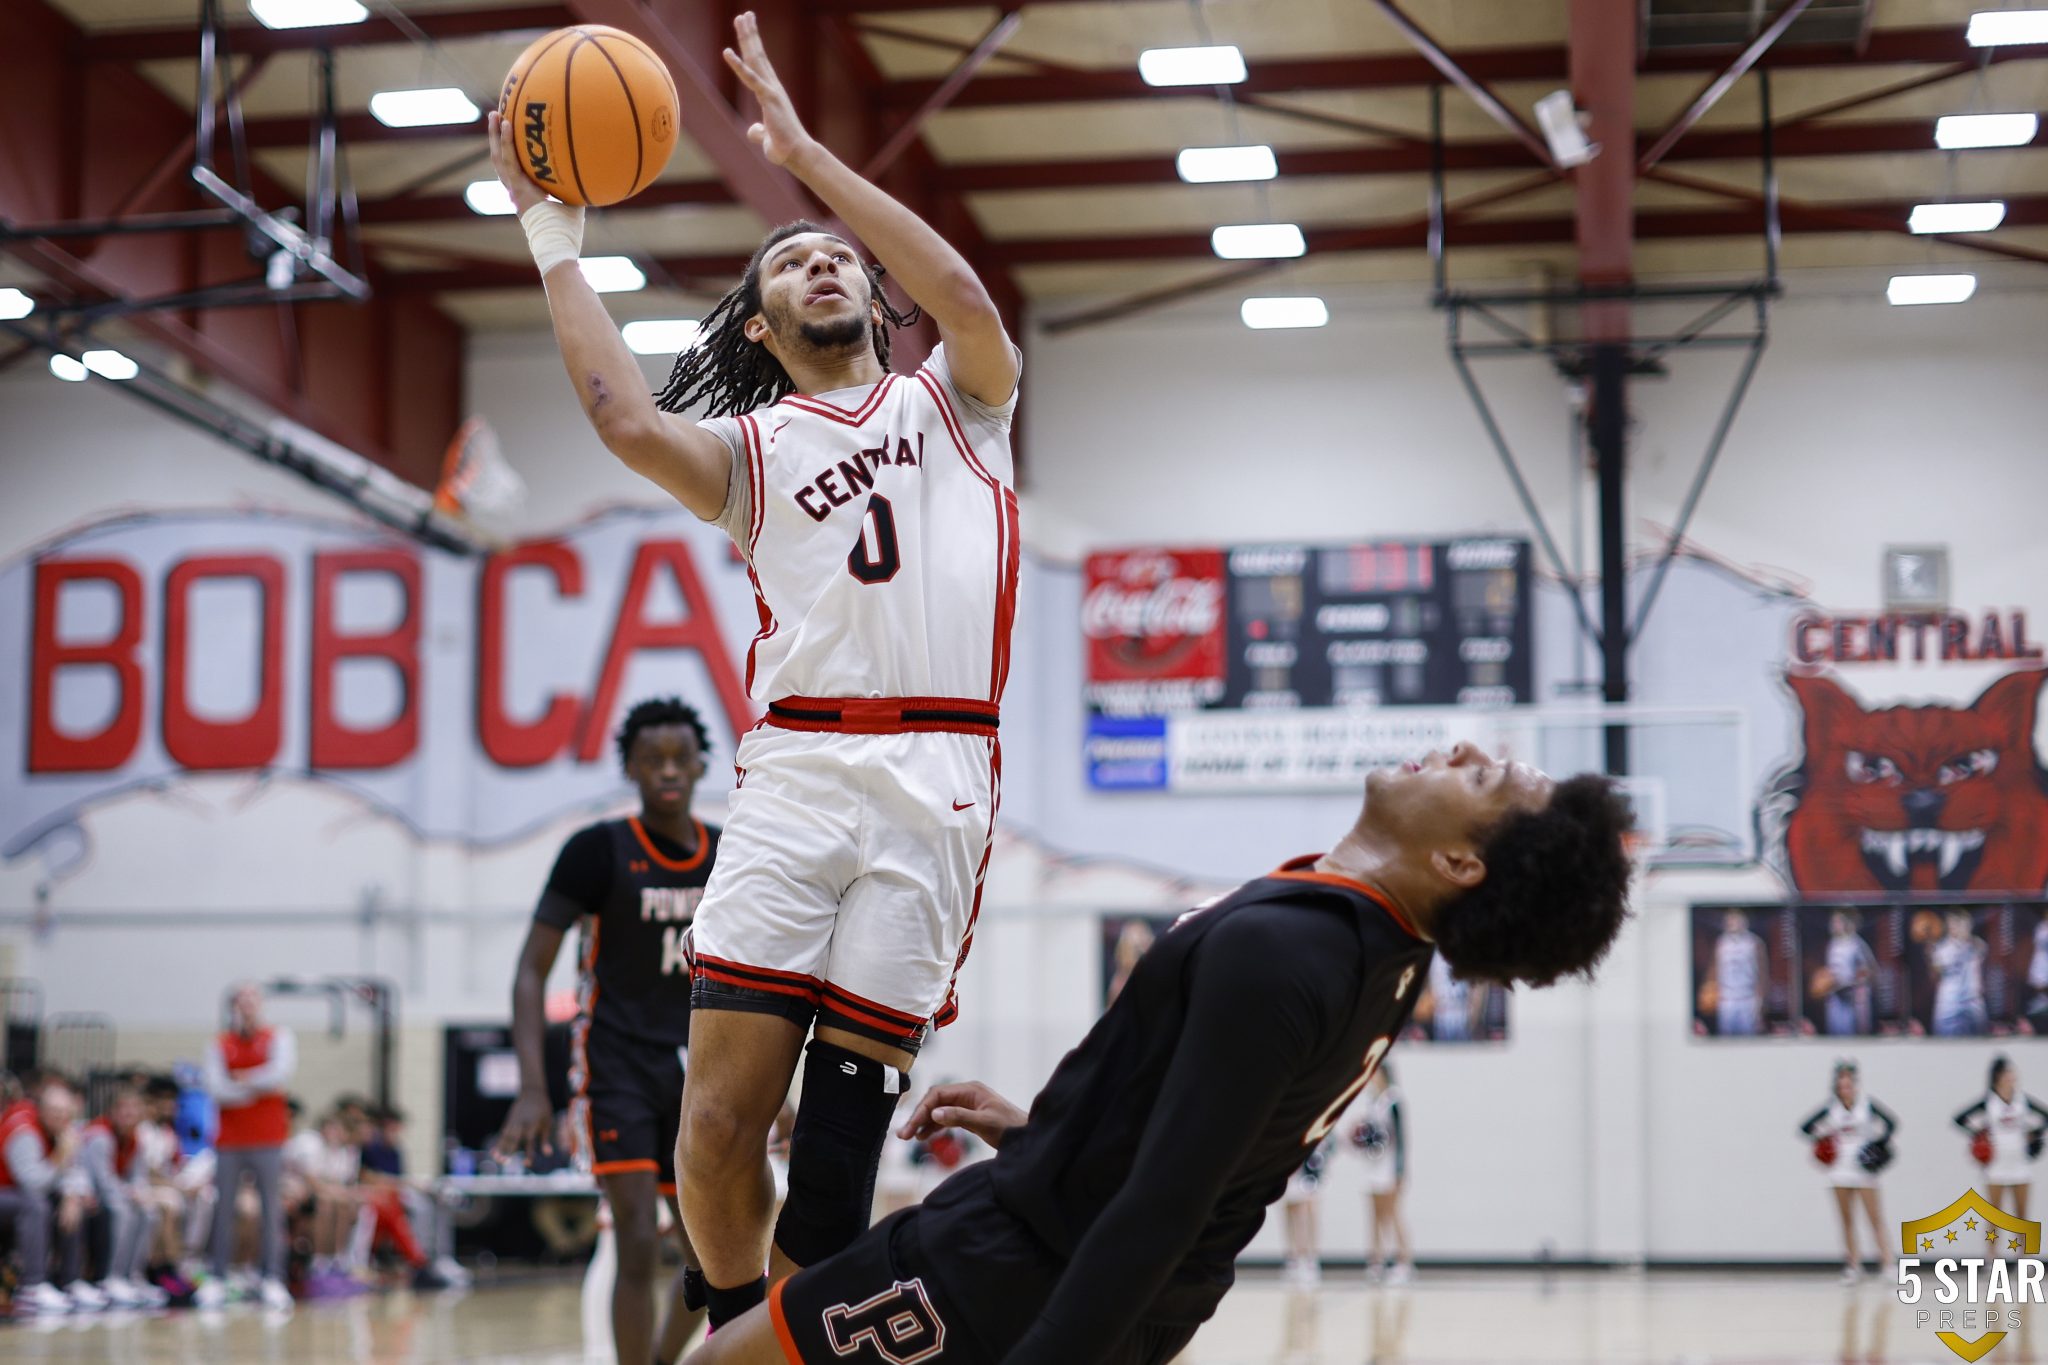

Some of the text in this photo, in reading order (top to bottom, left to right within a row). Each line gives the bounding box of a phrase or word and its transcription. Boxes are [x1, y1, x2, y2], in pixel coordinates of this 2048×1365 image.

[525, 102, 557, 184] NCAA
[847, 492, 901, 586] 0
[1795, 611, 2043, 664] CENTRAL
[822, 1277, 946, 1365] P
